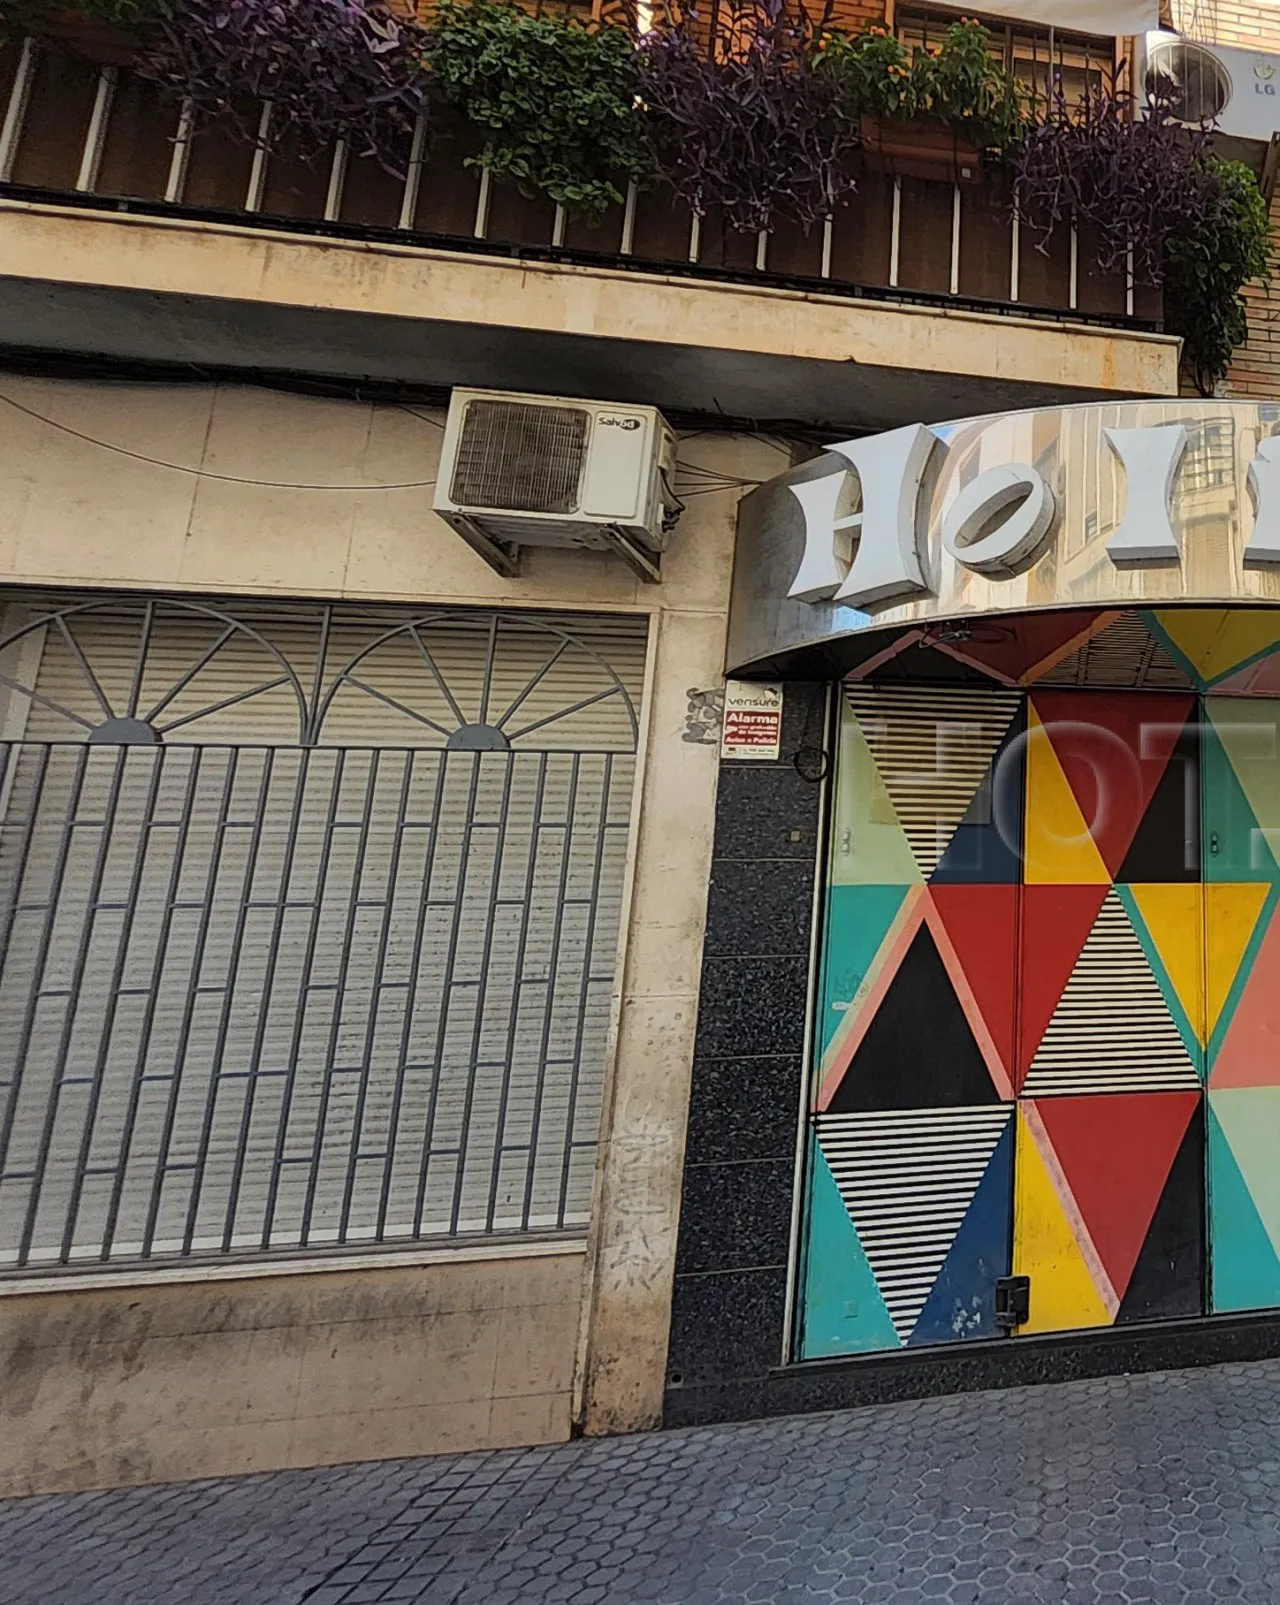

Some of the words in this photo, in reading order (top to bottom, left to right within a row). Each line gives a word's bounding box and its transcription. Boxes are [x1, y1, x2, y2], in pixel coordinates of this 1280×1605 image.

[1254, 83, 1275, 96] LG
[729, 698, 780, 707] verisure
[727, 712, 778, 724] Alarma
